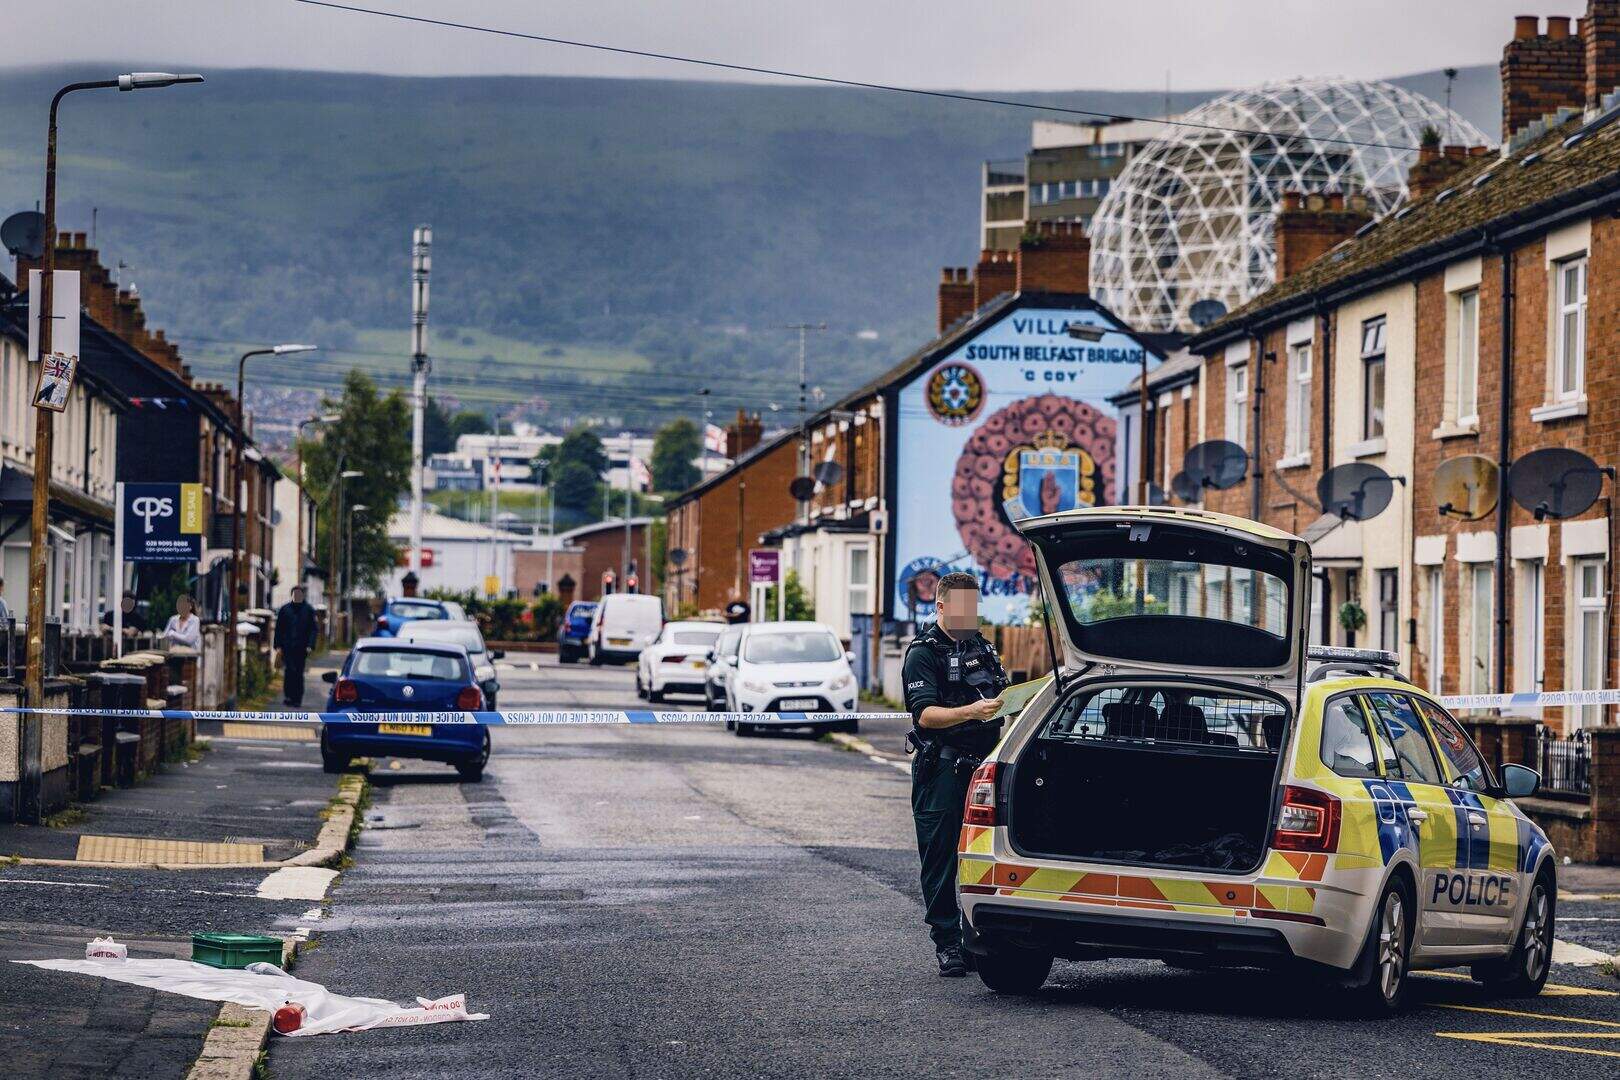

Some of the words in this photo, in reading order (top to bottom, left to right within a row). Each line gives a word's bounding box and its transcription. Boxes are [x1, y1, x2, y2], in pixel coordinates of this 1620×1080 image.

[1013, 318, 1095, 335] VILLA
[966, 344, 1020, 361] SOUTH
[1023, 345, 1084, 362] BELFAST
[1087, 348, 1144, 364] BRIGADE
[132, 496, 174, 534] cps
[965, 658, 979, 667] POLICE
[908, 680, 925, 690] POLICE
[279, 712, 309, 720] POLICE
[352, 712, 380, 721] CROSS
[382, 712, 398, 721] NOT
[401, 712, 412, 721] DO
[415, 712, 433, 722] LINE
[436, 712, 465, 722] POLICE
[507, 712, 536, 723] CROSS
[539, 712, 554, 722] NOT
[556, 712, 567, 722] DO
[570, 712, 588, 722] LINE
[590, 712, 619, 722] POLICE
[1432, 873, 1511, 906] POLICE
